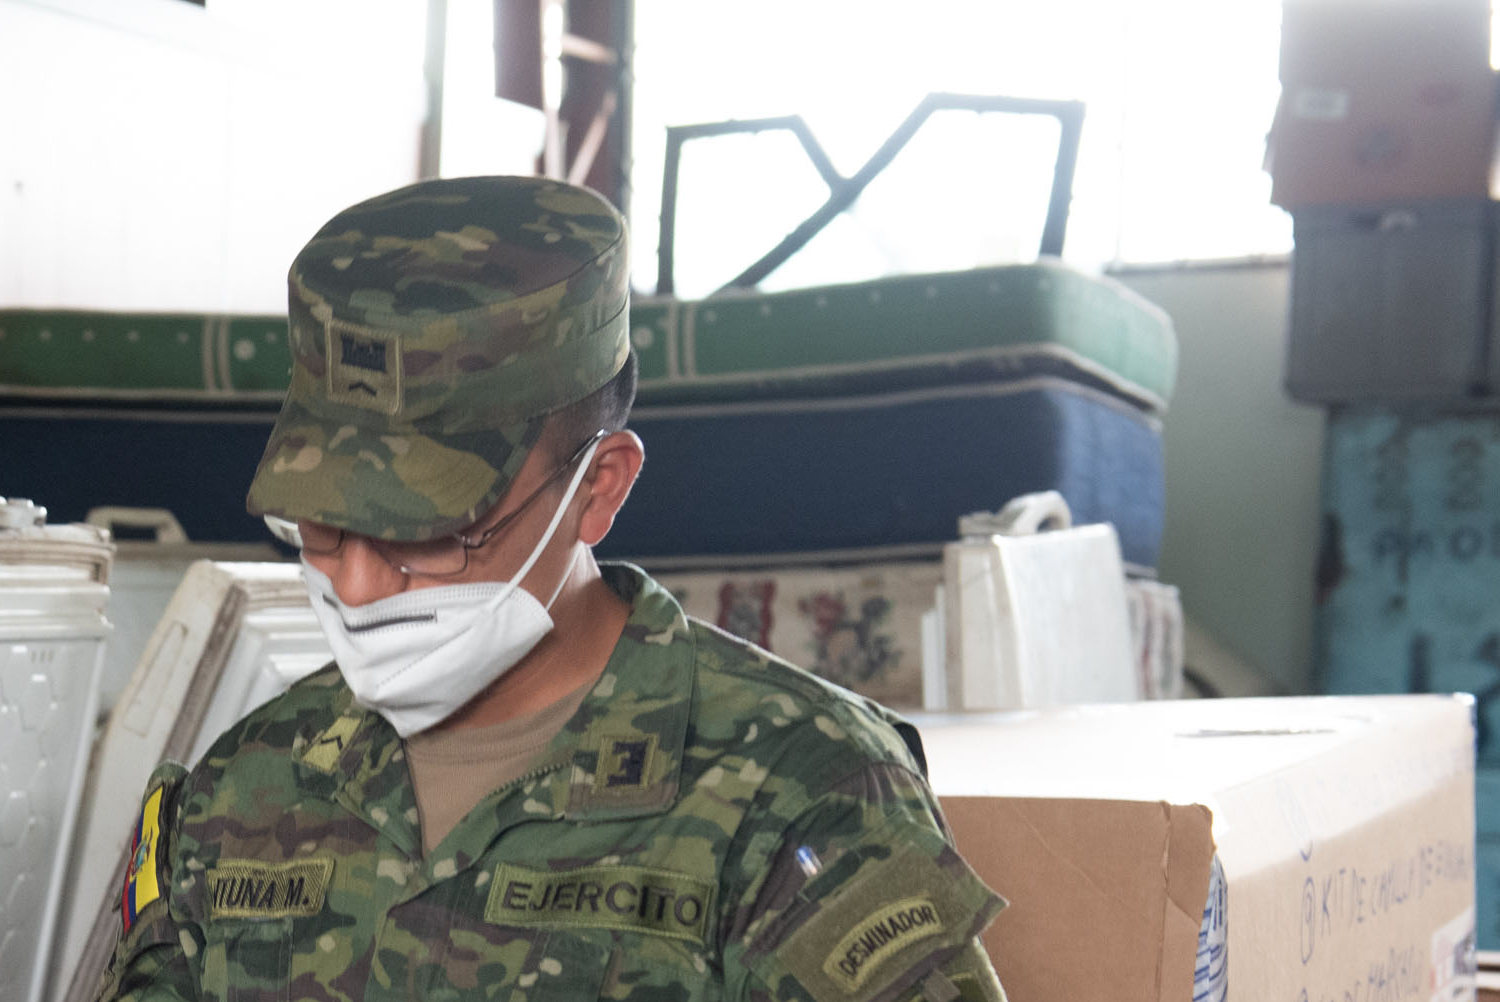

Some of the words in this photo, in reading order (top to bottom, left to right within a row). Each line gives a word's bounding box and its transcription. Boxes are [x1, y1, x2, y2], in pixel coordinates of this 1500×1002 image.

[284, 877, 310, 907] M.
[501, 880, 701, 927] EJERCITO
[837, 905, 937, 977] DESMINADOR
